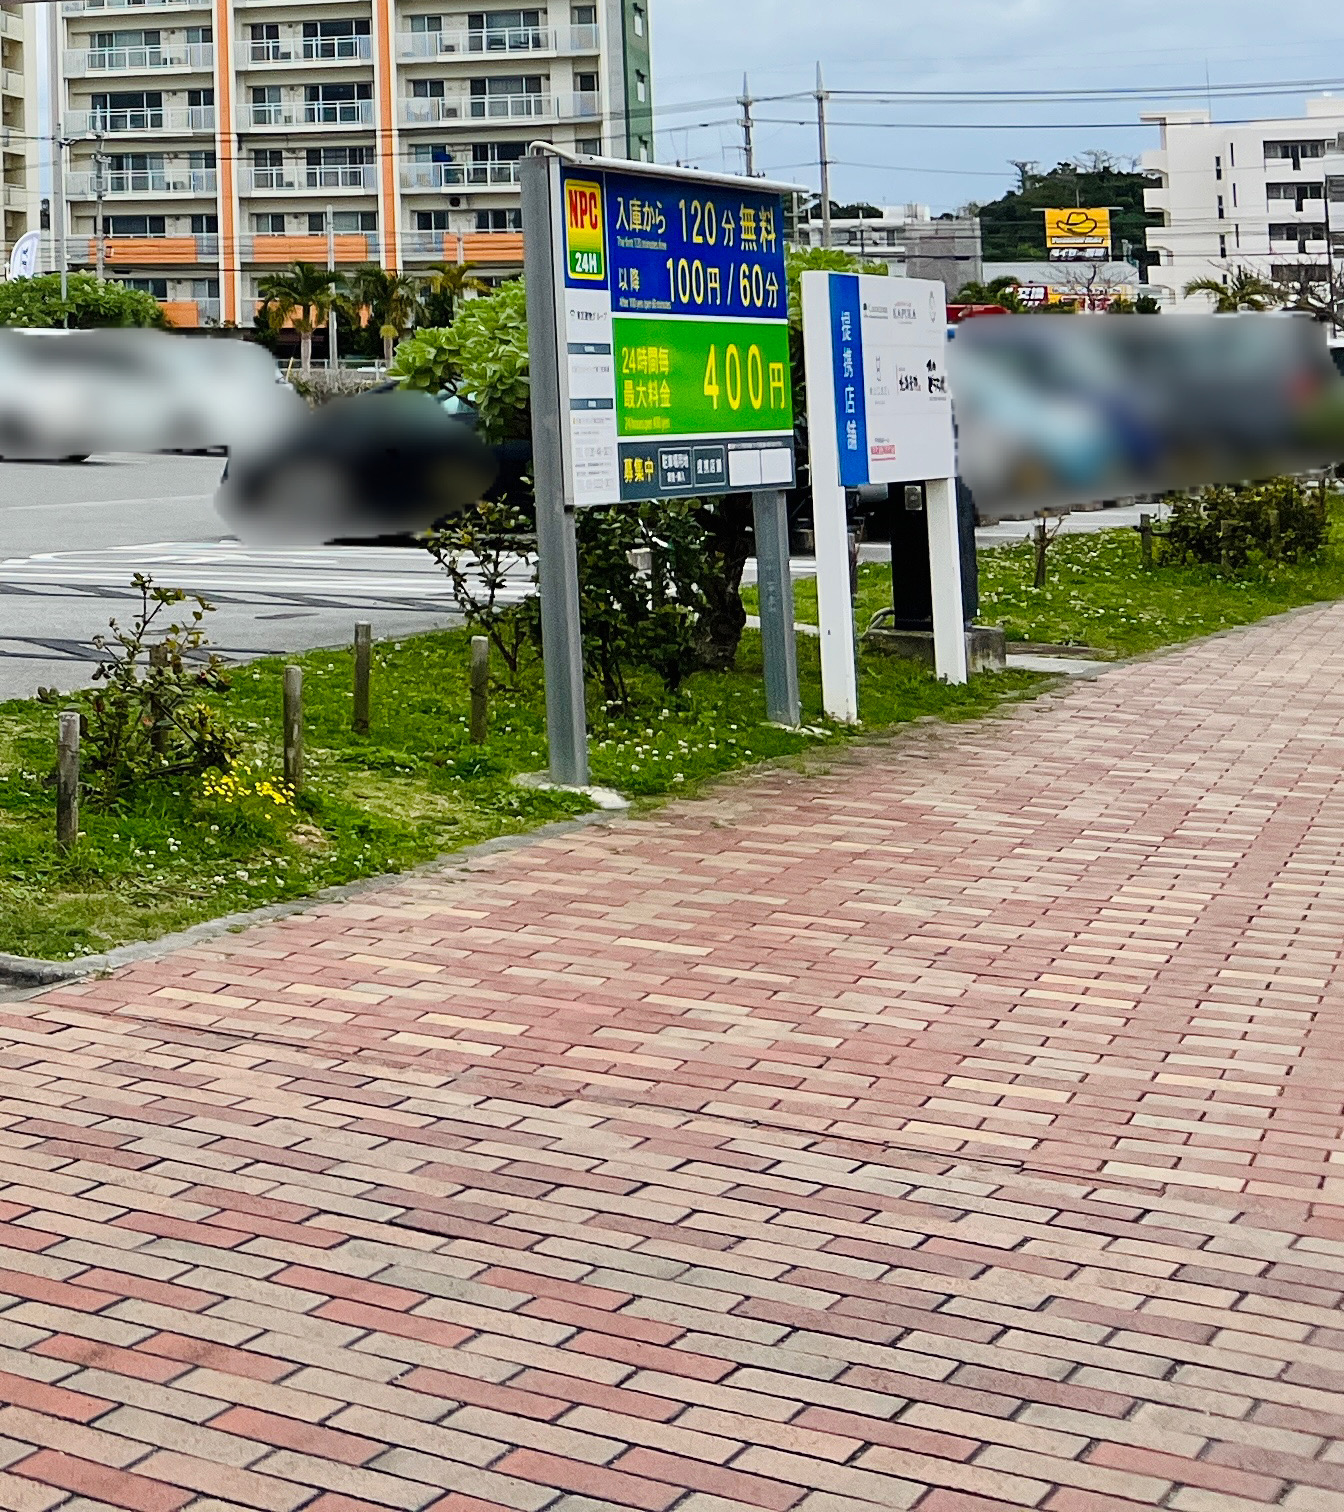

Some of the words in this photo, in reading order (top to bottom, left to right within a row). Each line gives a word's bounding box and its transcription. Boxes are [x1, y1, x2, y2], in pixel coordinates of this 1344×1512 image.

[568, 190, 598, 230] NPC
[616, 197, 666, 234] 入庫から
[575, 252, 597, 273] 24H
[618, 267, 640, 292] 以降
[622, 346, 669, 375] 24時間毎
[703, 343, 785, 410] 400円
[623, 378, 671, 408] 最大料金
